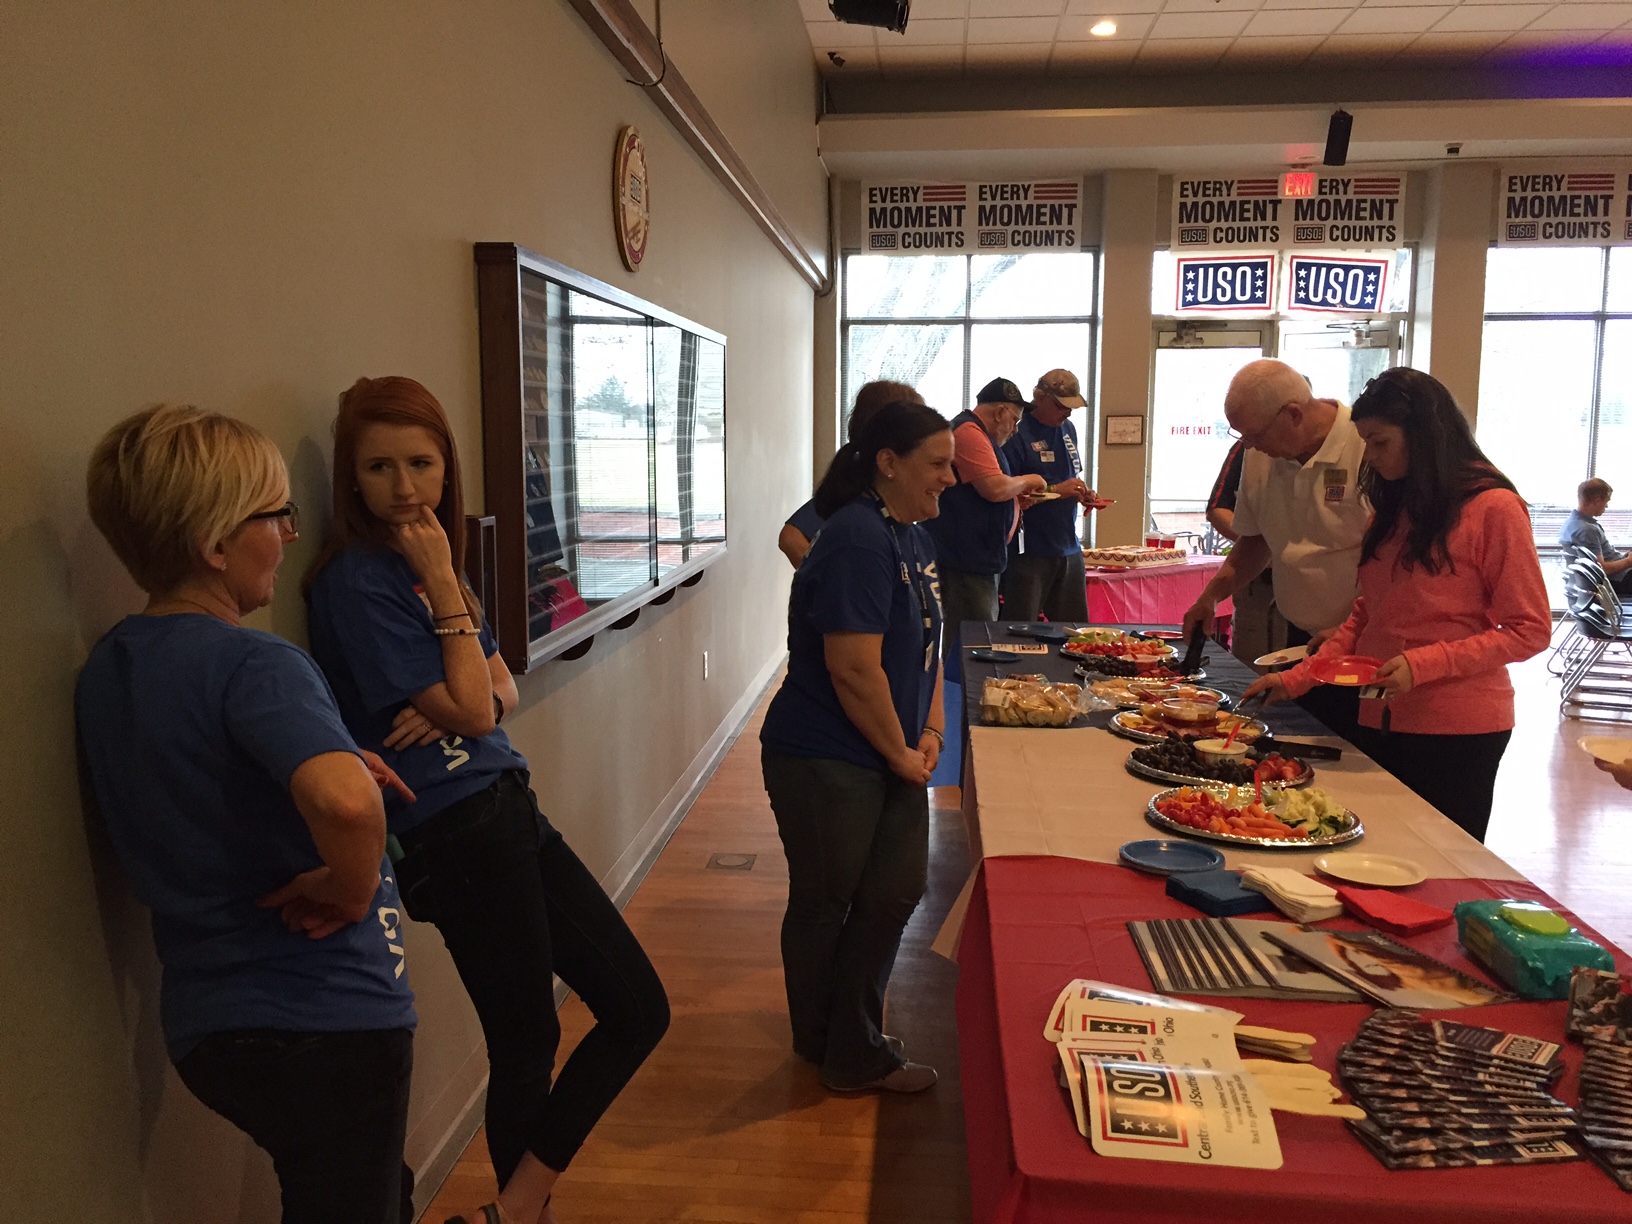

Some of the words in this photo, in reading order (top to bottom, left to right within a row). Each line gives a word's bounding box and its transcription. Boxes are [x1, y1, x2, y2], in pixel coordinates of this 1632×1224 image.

[978, 184, 1031, 202] EVERY
[1179, 180, 1234, 198] EVERY
[1284, 173, 1315, 196] EXIT
[1507, 174, 1566, 193] EVERY
[868, 186, 921, 204] EVERY
[978, 203, 1078, 227] MOMENT
[1178, 199, 1282, 224] MOMENT
[1293, 198, 1399, 222] MOMENT
[1506, 194, 1615, 219] MOMENT
[868, 205, 967, 229] MOMENT
[875, 236, 893, 247] USO
[901, 231, 965, 249] COUNTS
[985, 234, 1001, 245] USO
[1011, 229, 1075, 247] COUNTS
[1185, 231, 1204, 242] USO
[1213, 225, 1280, 243] COUNTS
[1301, 228, 1319, 240] USO
[1329, 224, 1396, 242] COUNTS
[1513, 226, 1531, 237] USO
[1542, 221, 1611, 240] COUNTS
[1197, 266, 1251, 302] USO
[1308, 266, 1364, 305] USO
[1171, 427, 1189, 435] FIRE
[1193, 427, 1211, 435] EXIT
[1110, 1067, 1172, 1118] USO
[1250, 1119, 1257, 1128] to
[1250, 1129, 1260, 1144] Text
